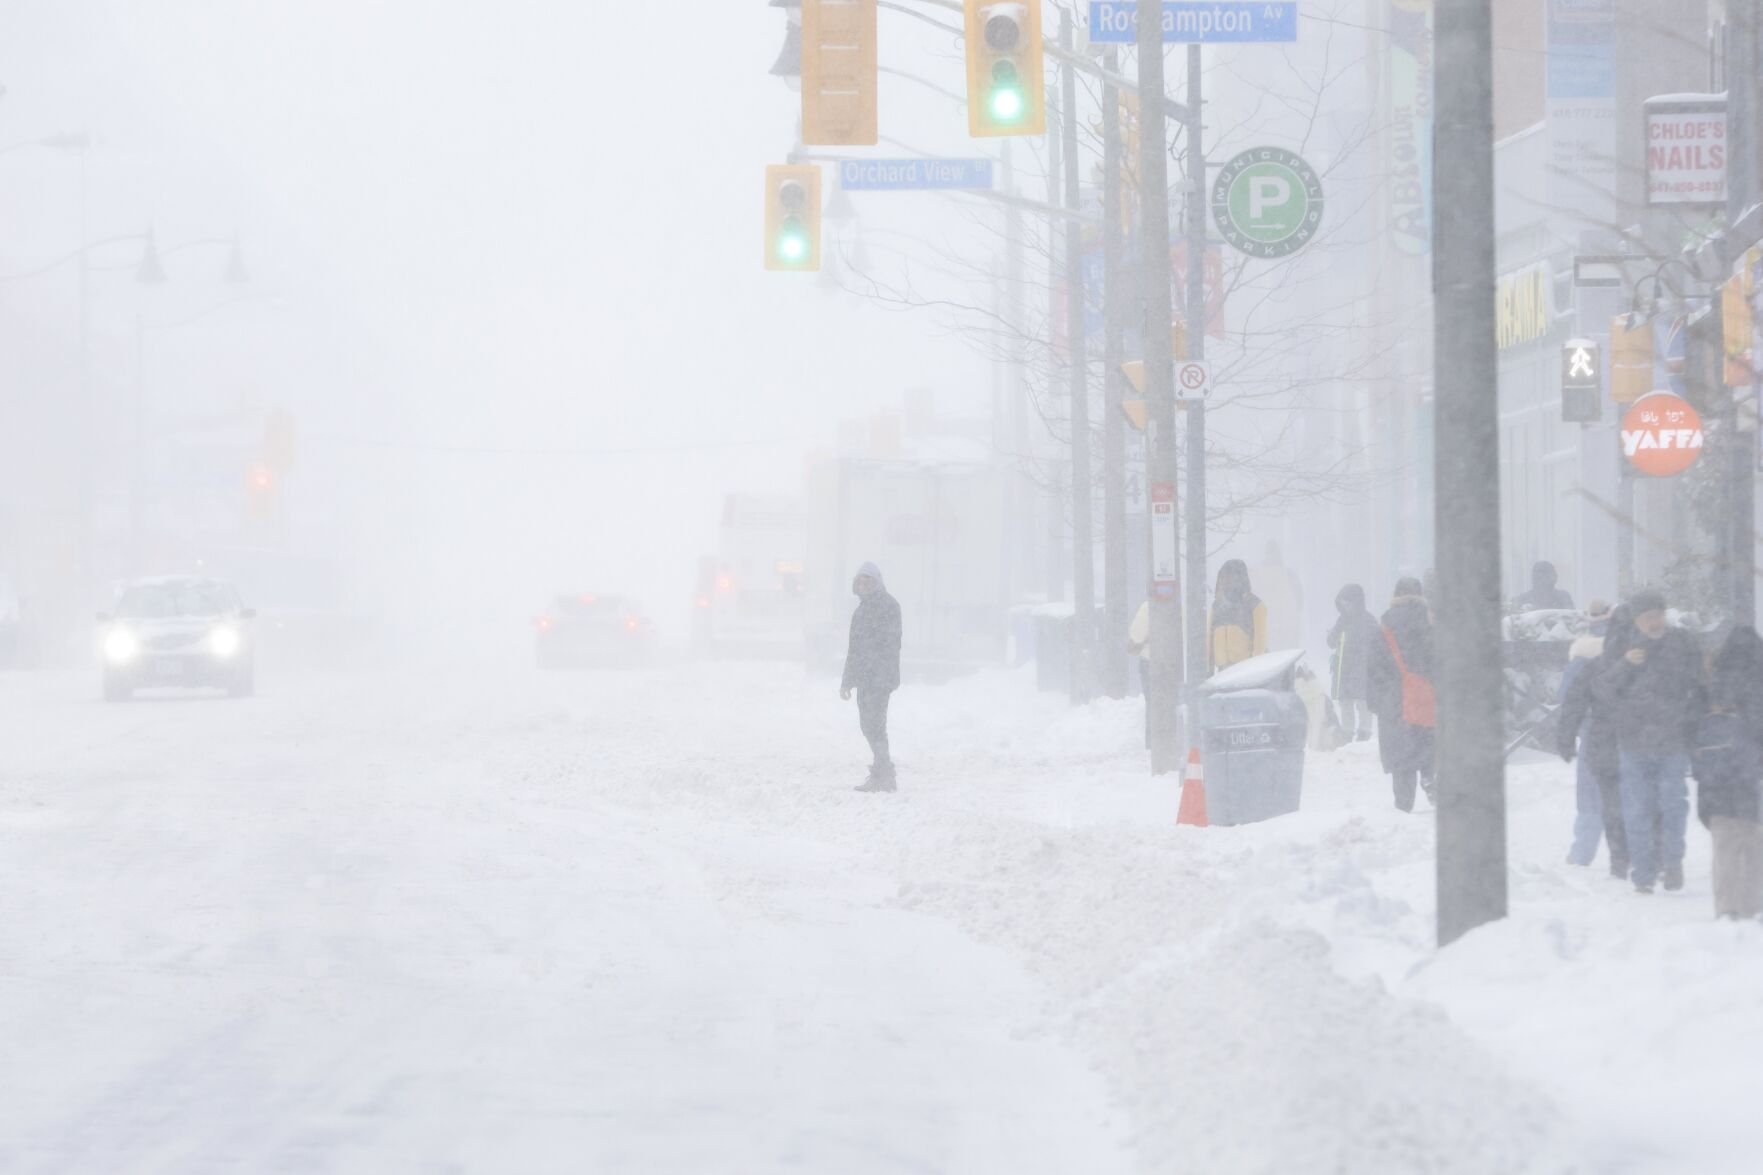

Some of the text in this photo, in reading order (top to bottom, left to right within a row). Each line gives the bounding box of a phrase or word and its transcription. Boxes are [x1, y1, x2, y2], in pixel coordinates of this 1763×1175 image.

[1100, 5, 1284, 38] Roampton Av
[1648, 121, 1724, 140] CHLOE'S
[846, 161, 917, 182] Orchard
[924, 161, 964, 181] View
[1646, 145, 1724, 170] NAILS
[1216, 151, 1318, 200] MUNICIPAL
[1249, 176, 1290, 218] P
[1218, 212, 1318, 256] PARKING
[1620, 428, 1704, 456] YAFFA
[1230, 731, 1257, 745] Litter
